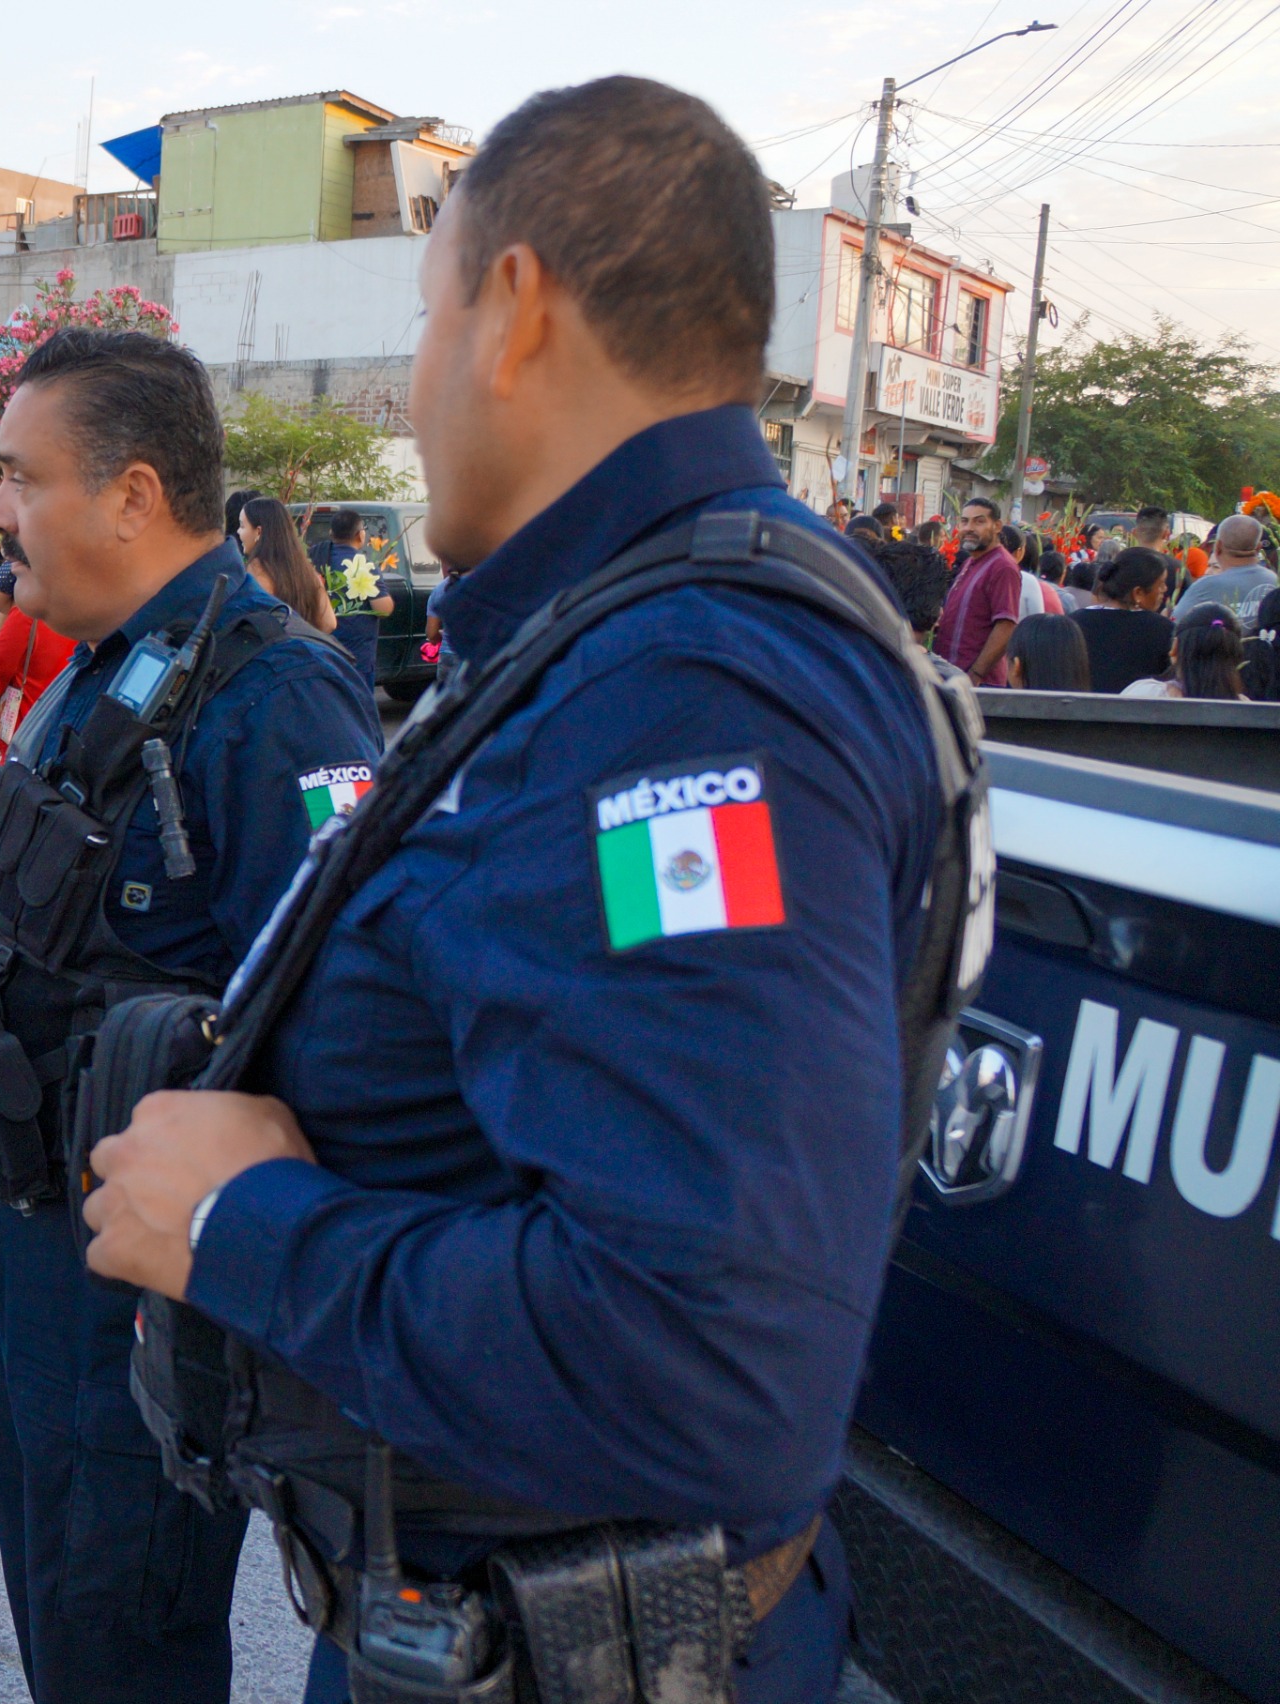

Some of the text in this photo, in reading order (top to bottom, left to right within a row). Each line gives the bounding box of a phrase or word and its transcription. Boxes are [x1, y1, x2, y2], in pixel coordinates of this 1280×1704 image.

[925, 367, 962, 394] MINI SUPER
[919, 385, 965, 425] VALLE VERDE
[298, 766, 372, 791] MÉXICO
[597, 766, 762, 831] MÉXICO
[1053, 998, 1280, 1243] MU
